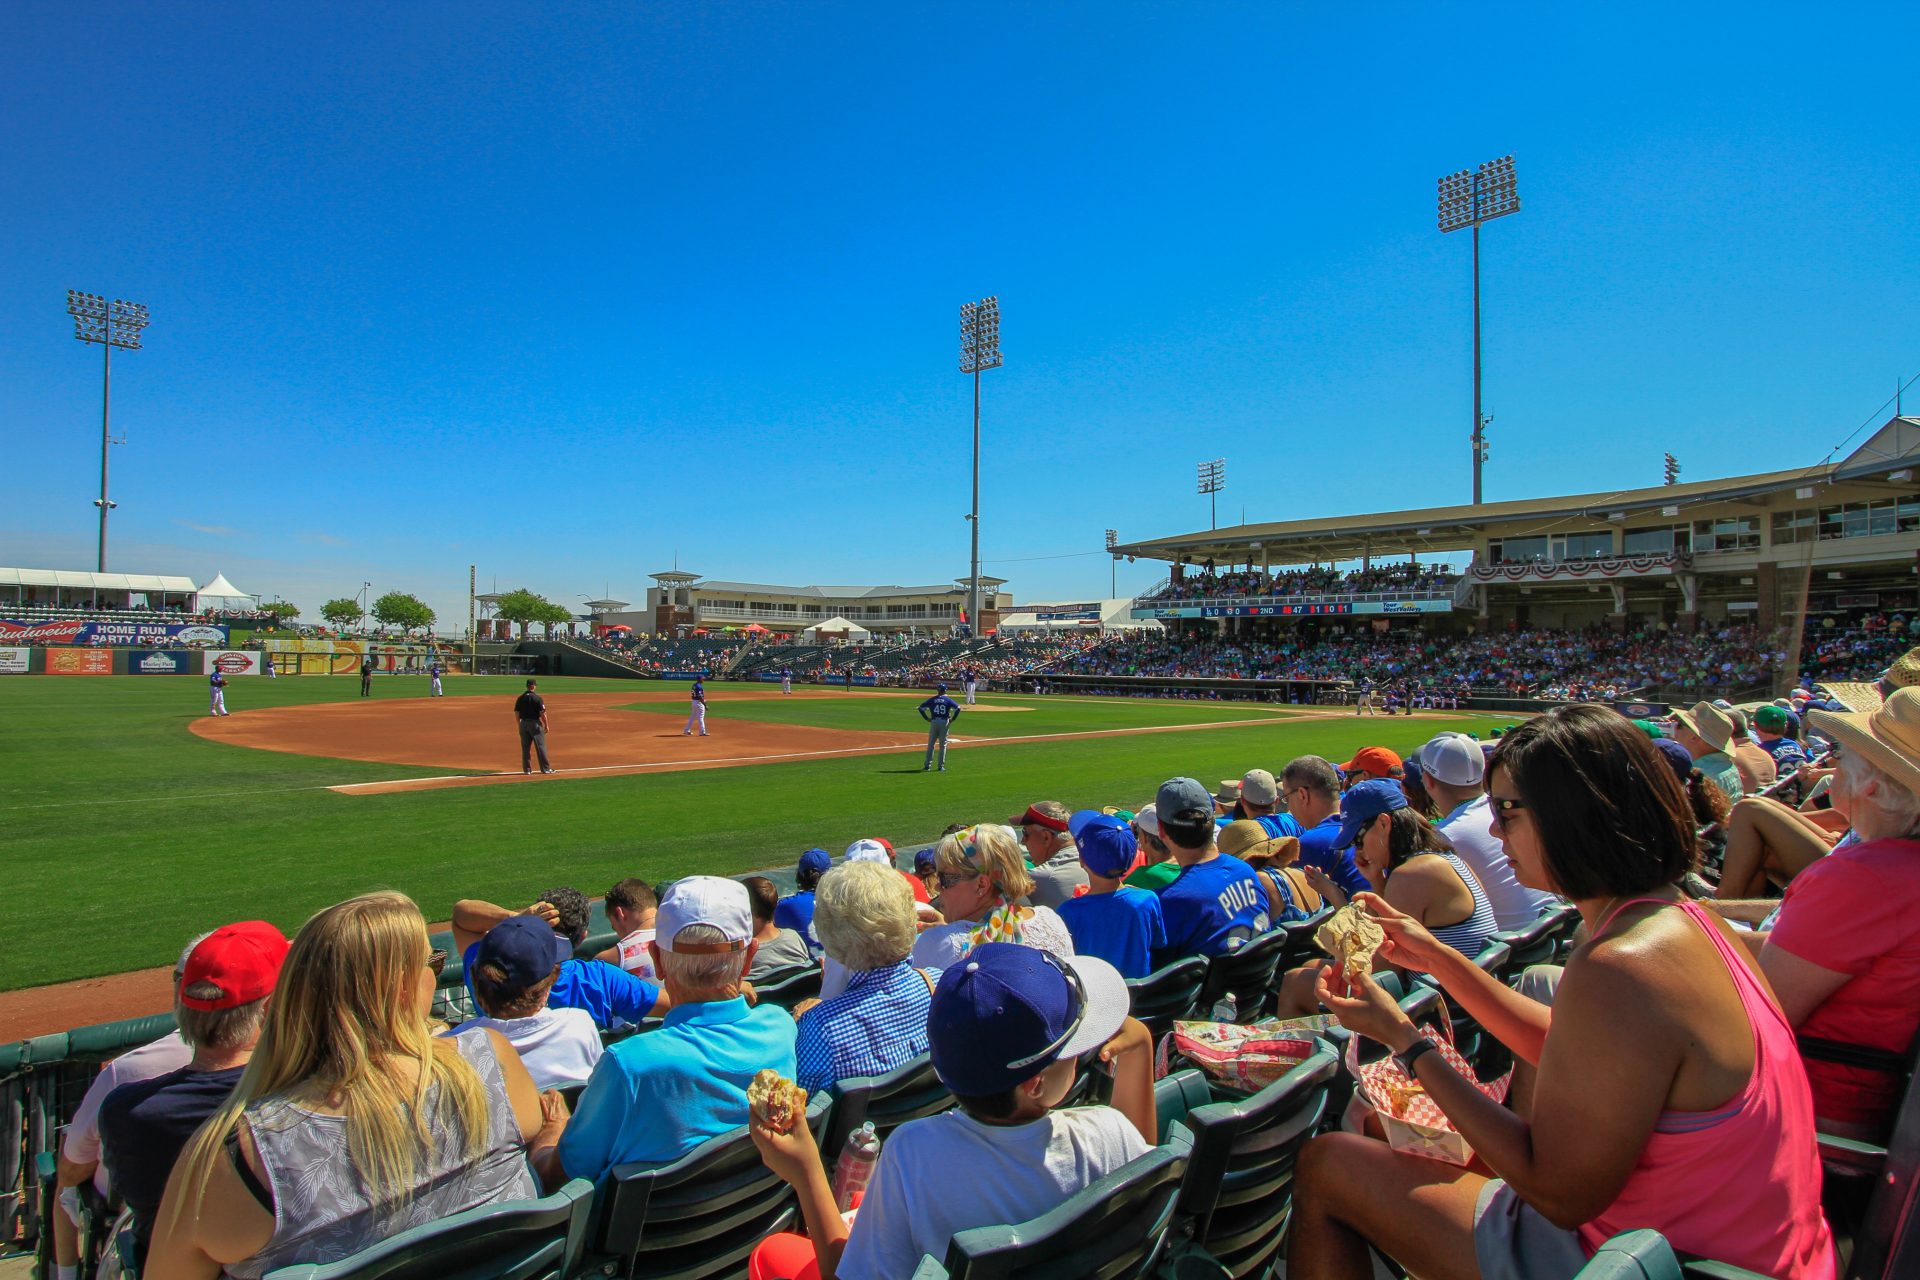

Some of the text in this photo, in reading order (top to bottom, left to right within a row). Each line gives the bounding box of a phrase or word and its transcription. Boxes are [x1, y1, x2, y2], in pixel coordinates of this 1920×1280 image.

[1214, 608, 1219, 616] 0
[1235, 607, 1240, 615] 0
[1293, 606, 1303, 614] 47
[1316, 605, 1320, 613] 1
[1329, 605, 1335, 613] 0
[1343, 604, 1348, 612] 1
[0, 626, 87, 639] Budweiser
[97, 625, 166, 635] HOME RUN
[91, 635, 169, 643] PARTY DCK
[933, 704, 946, 715] 49
[1218, 878, 1258, 921] PUIG
